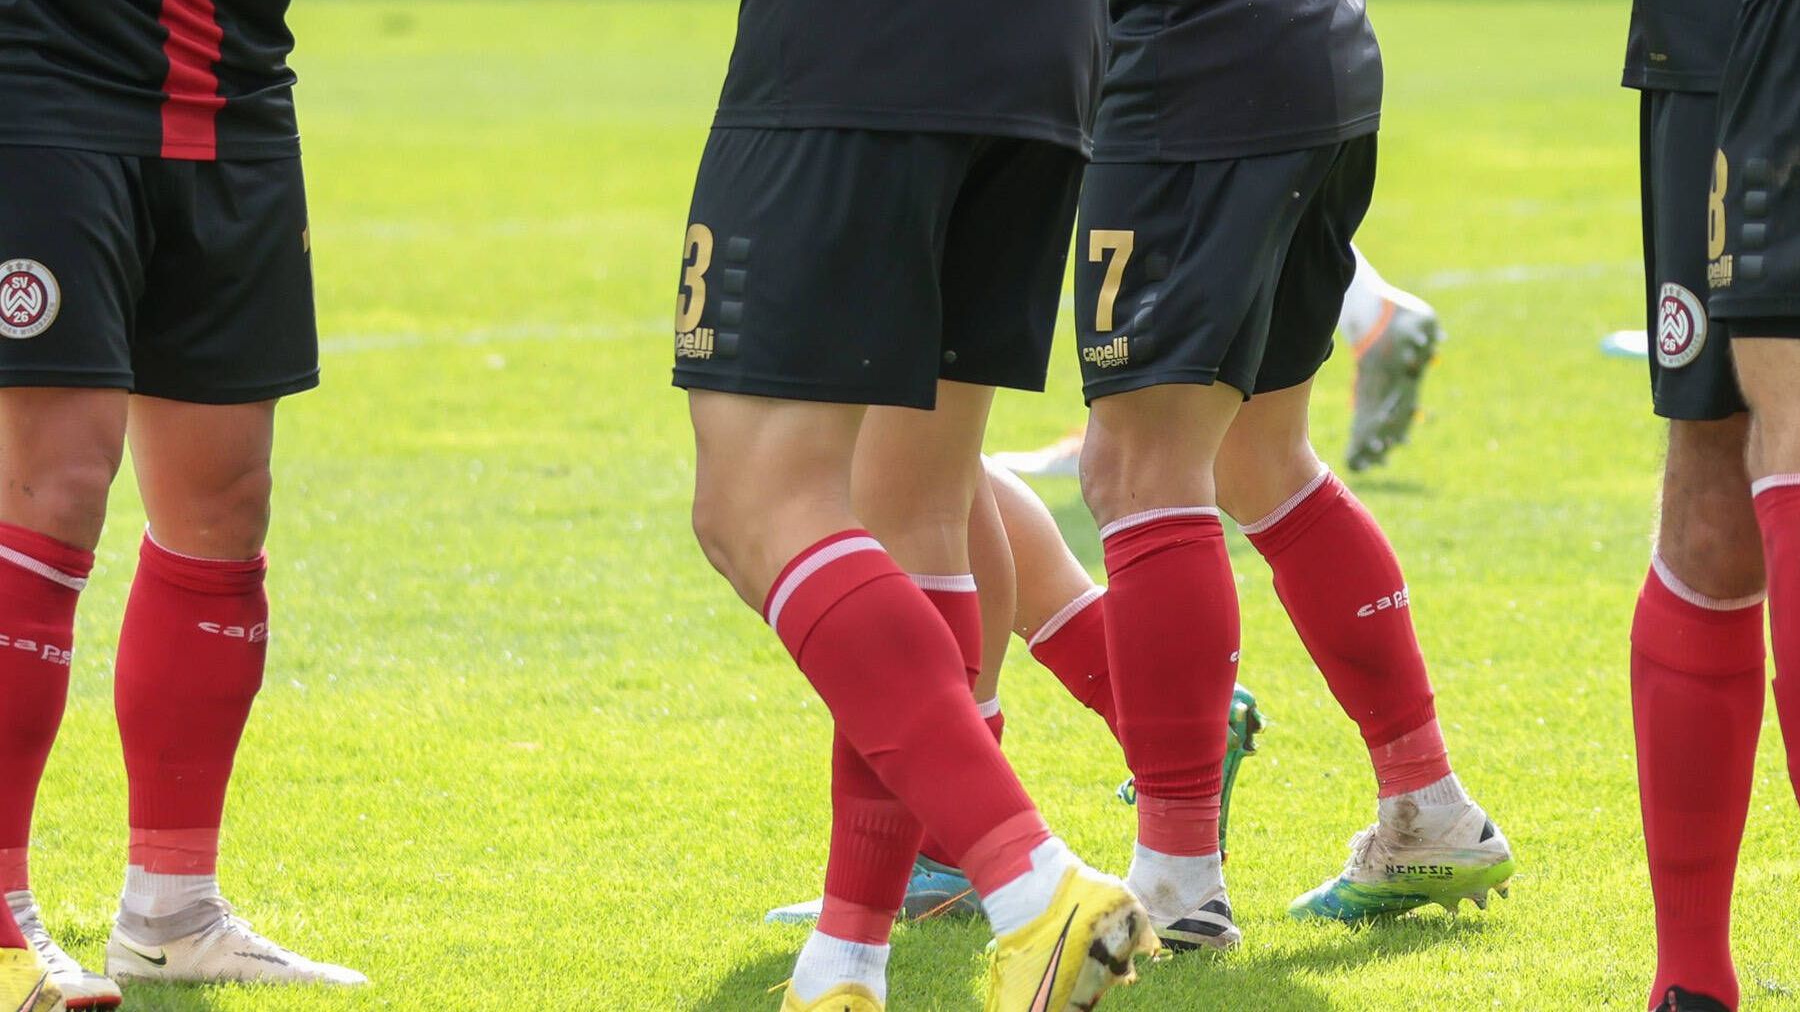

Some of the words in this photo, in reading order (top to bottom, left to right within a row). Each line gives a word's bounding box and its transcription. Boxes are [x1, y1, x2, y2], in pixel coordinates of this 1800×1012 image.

[12, 277, 29, 288] SV
[1088, 230, 1135, 331] 7
[13, 311, 29, 322] 26
[676, 328, 714, 350] pelli
[677, 349, 713, 359] PORT
[1083, 336, 1129, 367] capelli
[1101, 357, 1129, 368] SPORT
[1385, 864, 1454, 875] NEMESIS
